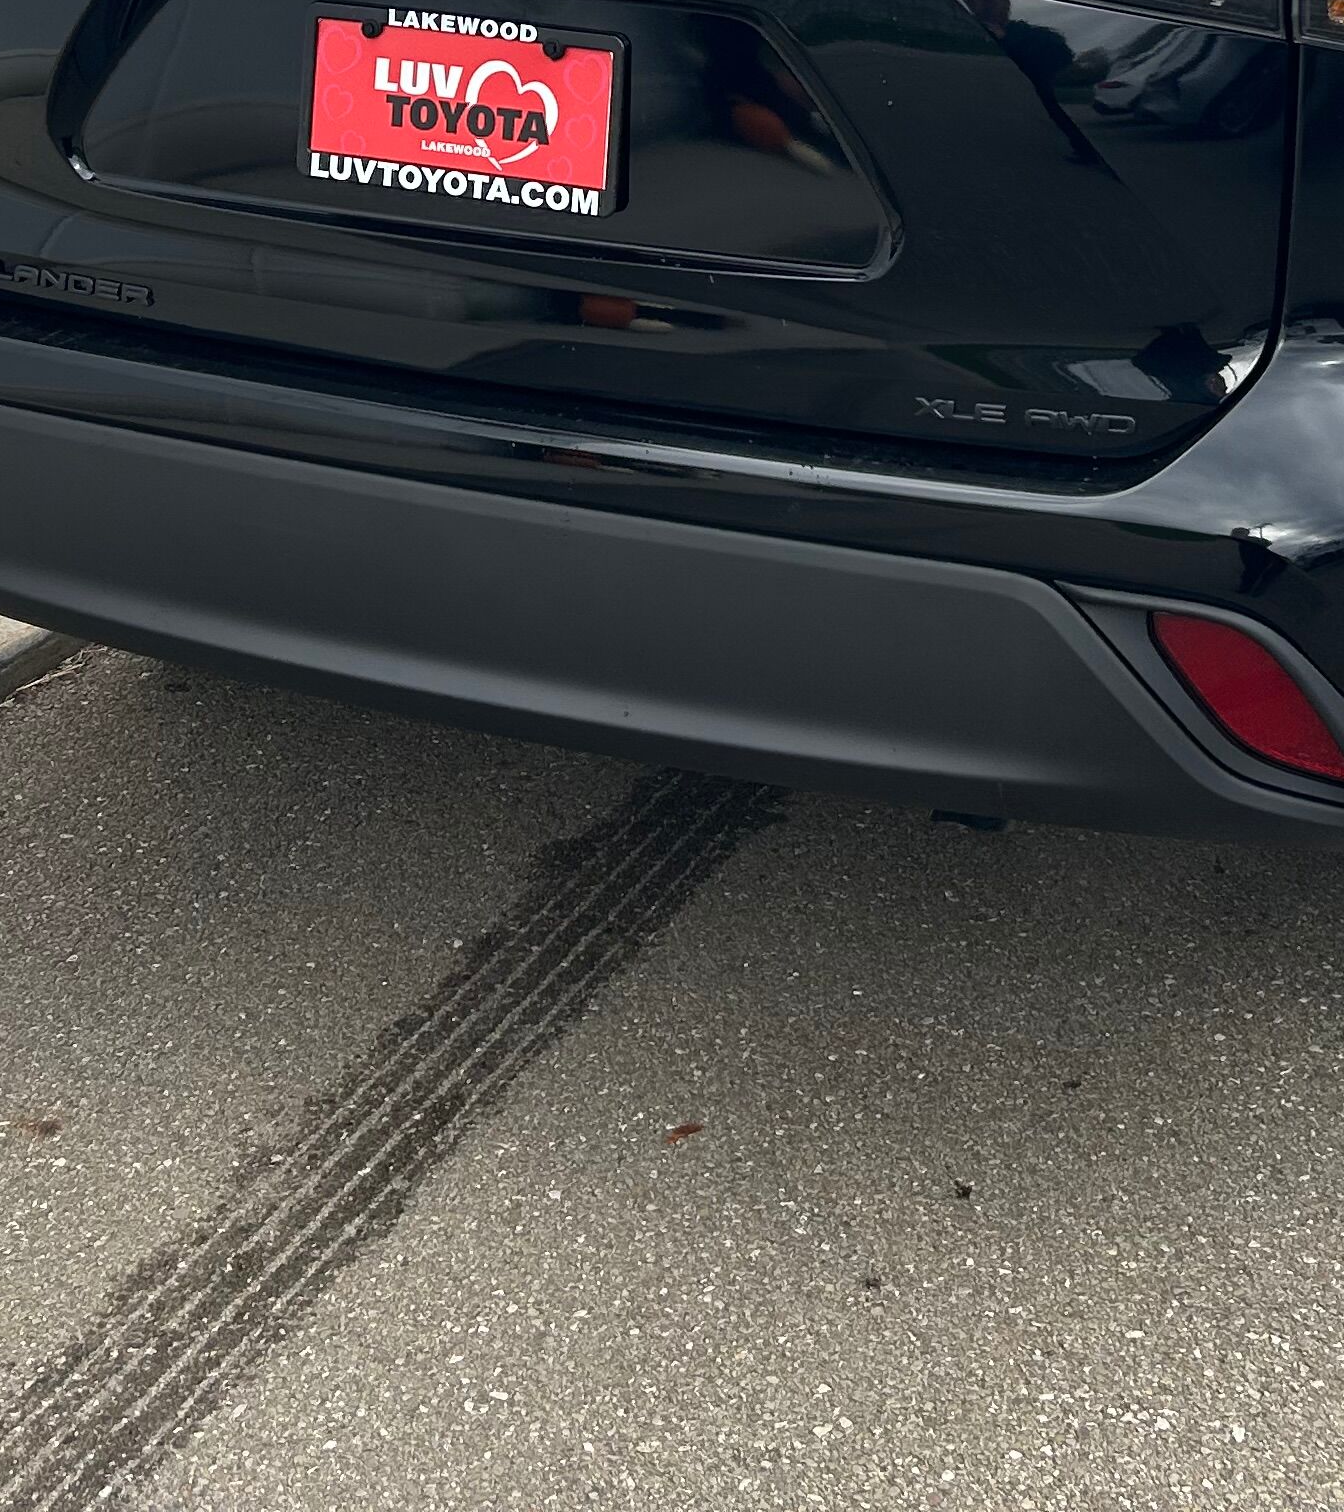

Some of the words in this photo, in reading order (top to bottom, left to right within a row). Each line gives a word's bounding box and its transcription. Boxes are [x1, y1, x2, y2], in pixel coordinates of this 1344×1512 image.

[388, 8, 538, 42] LAKEWOOD
[374, 56, 463, 98] LUV
[385, 94, 550, 145] TOYOTA
[420, 139, 491, 158] LAKEWOOD
[310, 152, 600, 216] LUVTOYOTA.COM
[914, 396, 1006, 423] XLE
